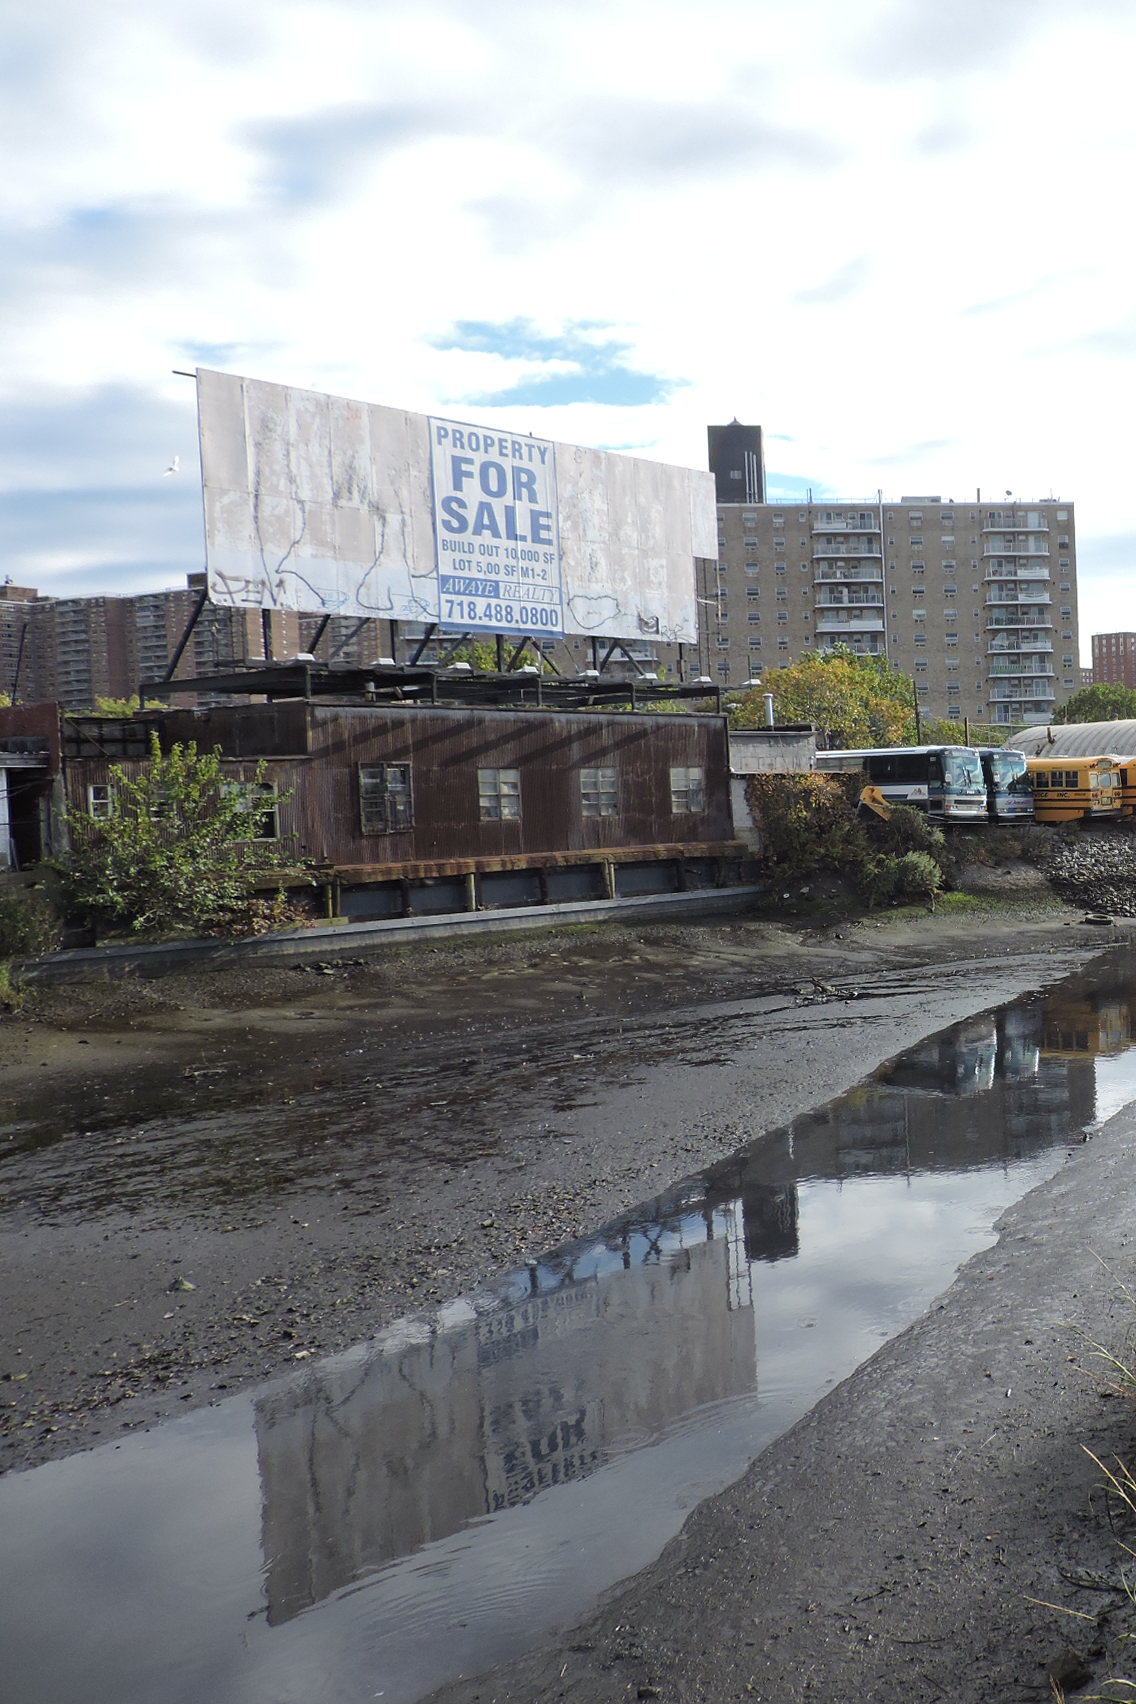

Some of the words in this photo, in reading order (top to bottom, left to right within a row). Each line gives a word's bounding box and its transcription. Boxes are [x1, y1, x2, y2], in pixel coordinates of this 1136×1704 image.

[436, 425, 549, 465] PROPERTY
[450, 454, 539, 505] FOR
[440, 495, 554, 546] SALE
[441, 539, 475, 555] BUILD
[479, 543, 500, 558] OUT
[543, 552, 556, 564] SF
[452, 558, 473, 572] LOT
[476, 561, 500, 576] 5,00
[503, 565, 517, 577] SF
[520, 566, 548, 581] M1-2
[443, 578, 495, 596] AWAYE
[502, 583, 558, 602] REALTY
[445, 599, 559, 628] 718.488.0800
